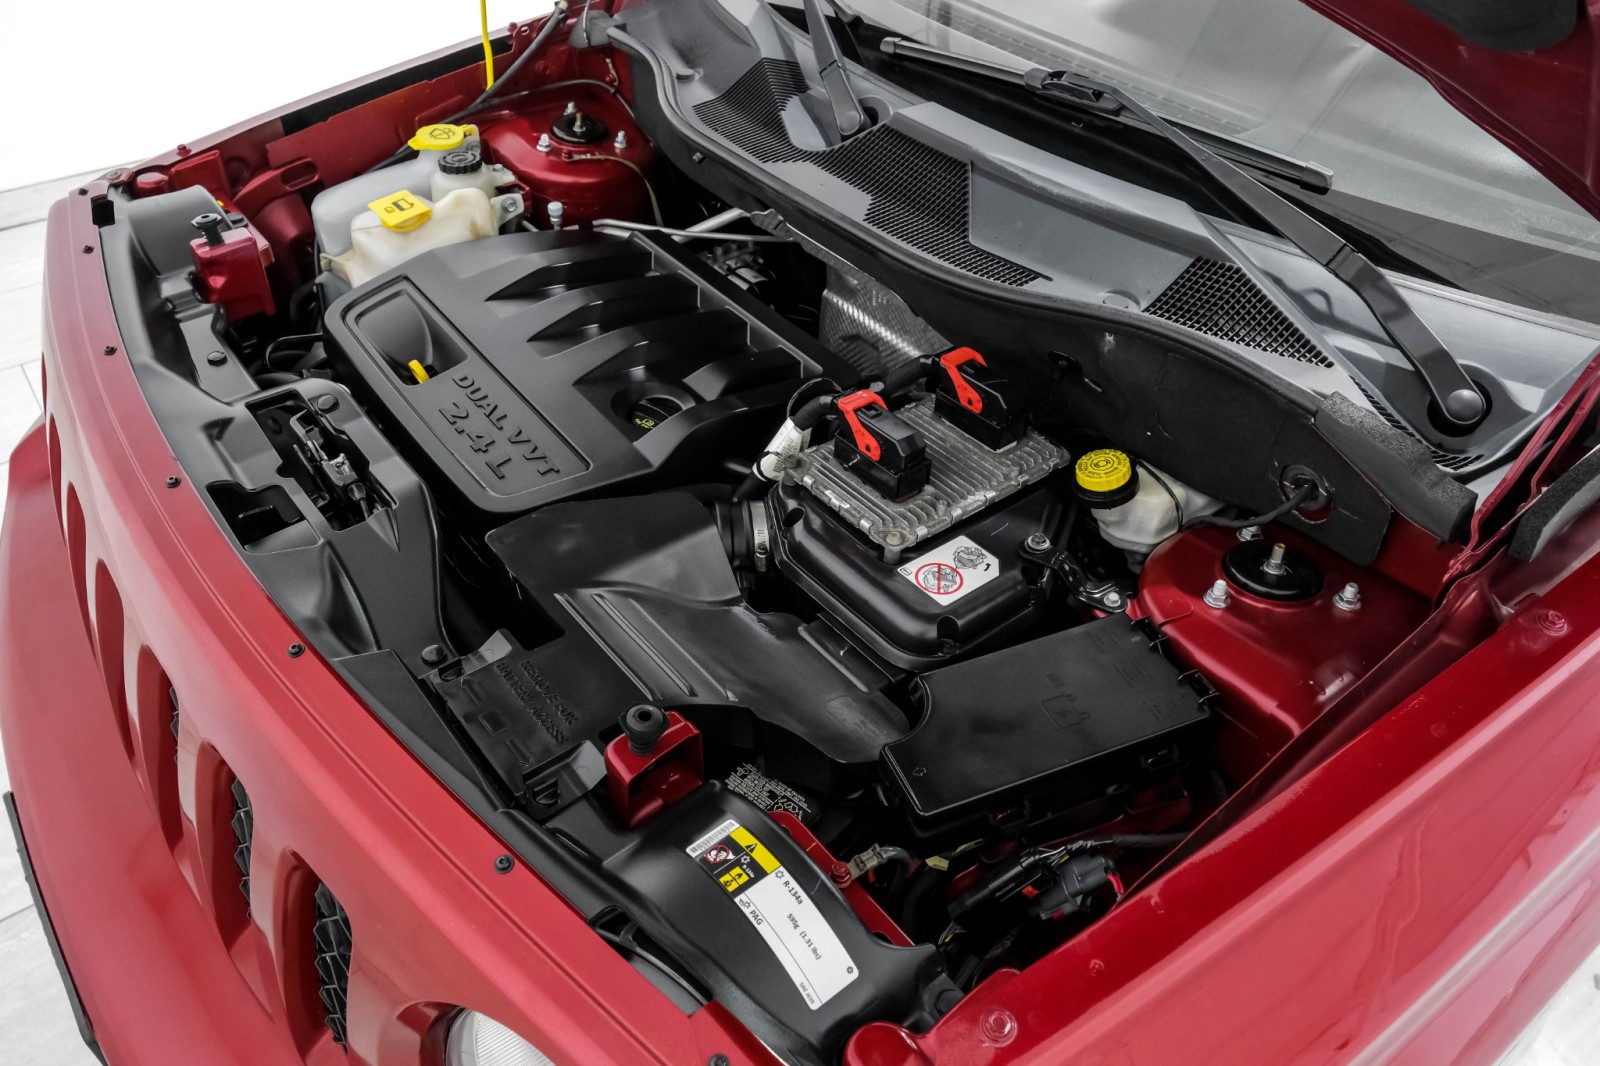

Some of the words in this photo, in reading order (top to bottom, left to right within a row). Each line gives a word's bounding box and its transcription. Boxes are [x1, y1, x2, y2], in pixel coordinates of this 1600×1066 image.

[452, 375, 507, 431] DUAL
[507, 426, 560, 476] VVT
[494, 661, 536, 706] BATTERY
[527, 705, 569, 744] ACCESS
[520, 660, 560, 705] REMOVE
[553, 702, 578, 726] FOR
[749, 909, 764, 926] PAG
[782, 880, 804, 905] R-134a
[786, 913, 800, 930] 595g
[799, 930, 814, 948] (1.31
[811, 946, 822, 960] lbs)
